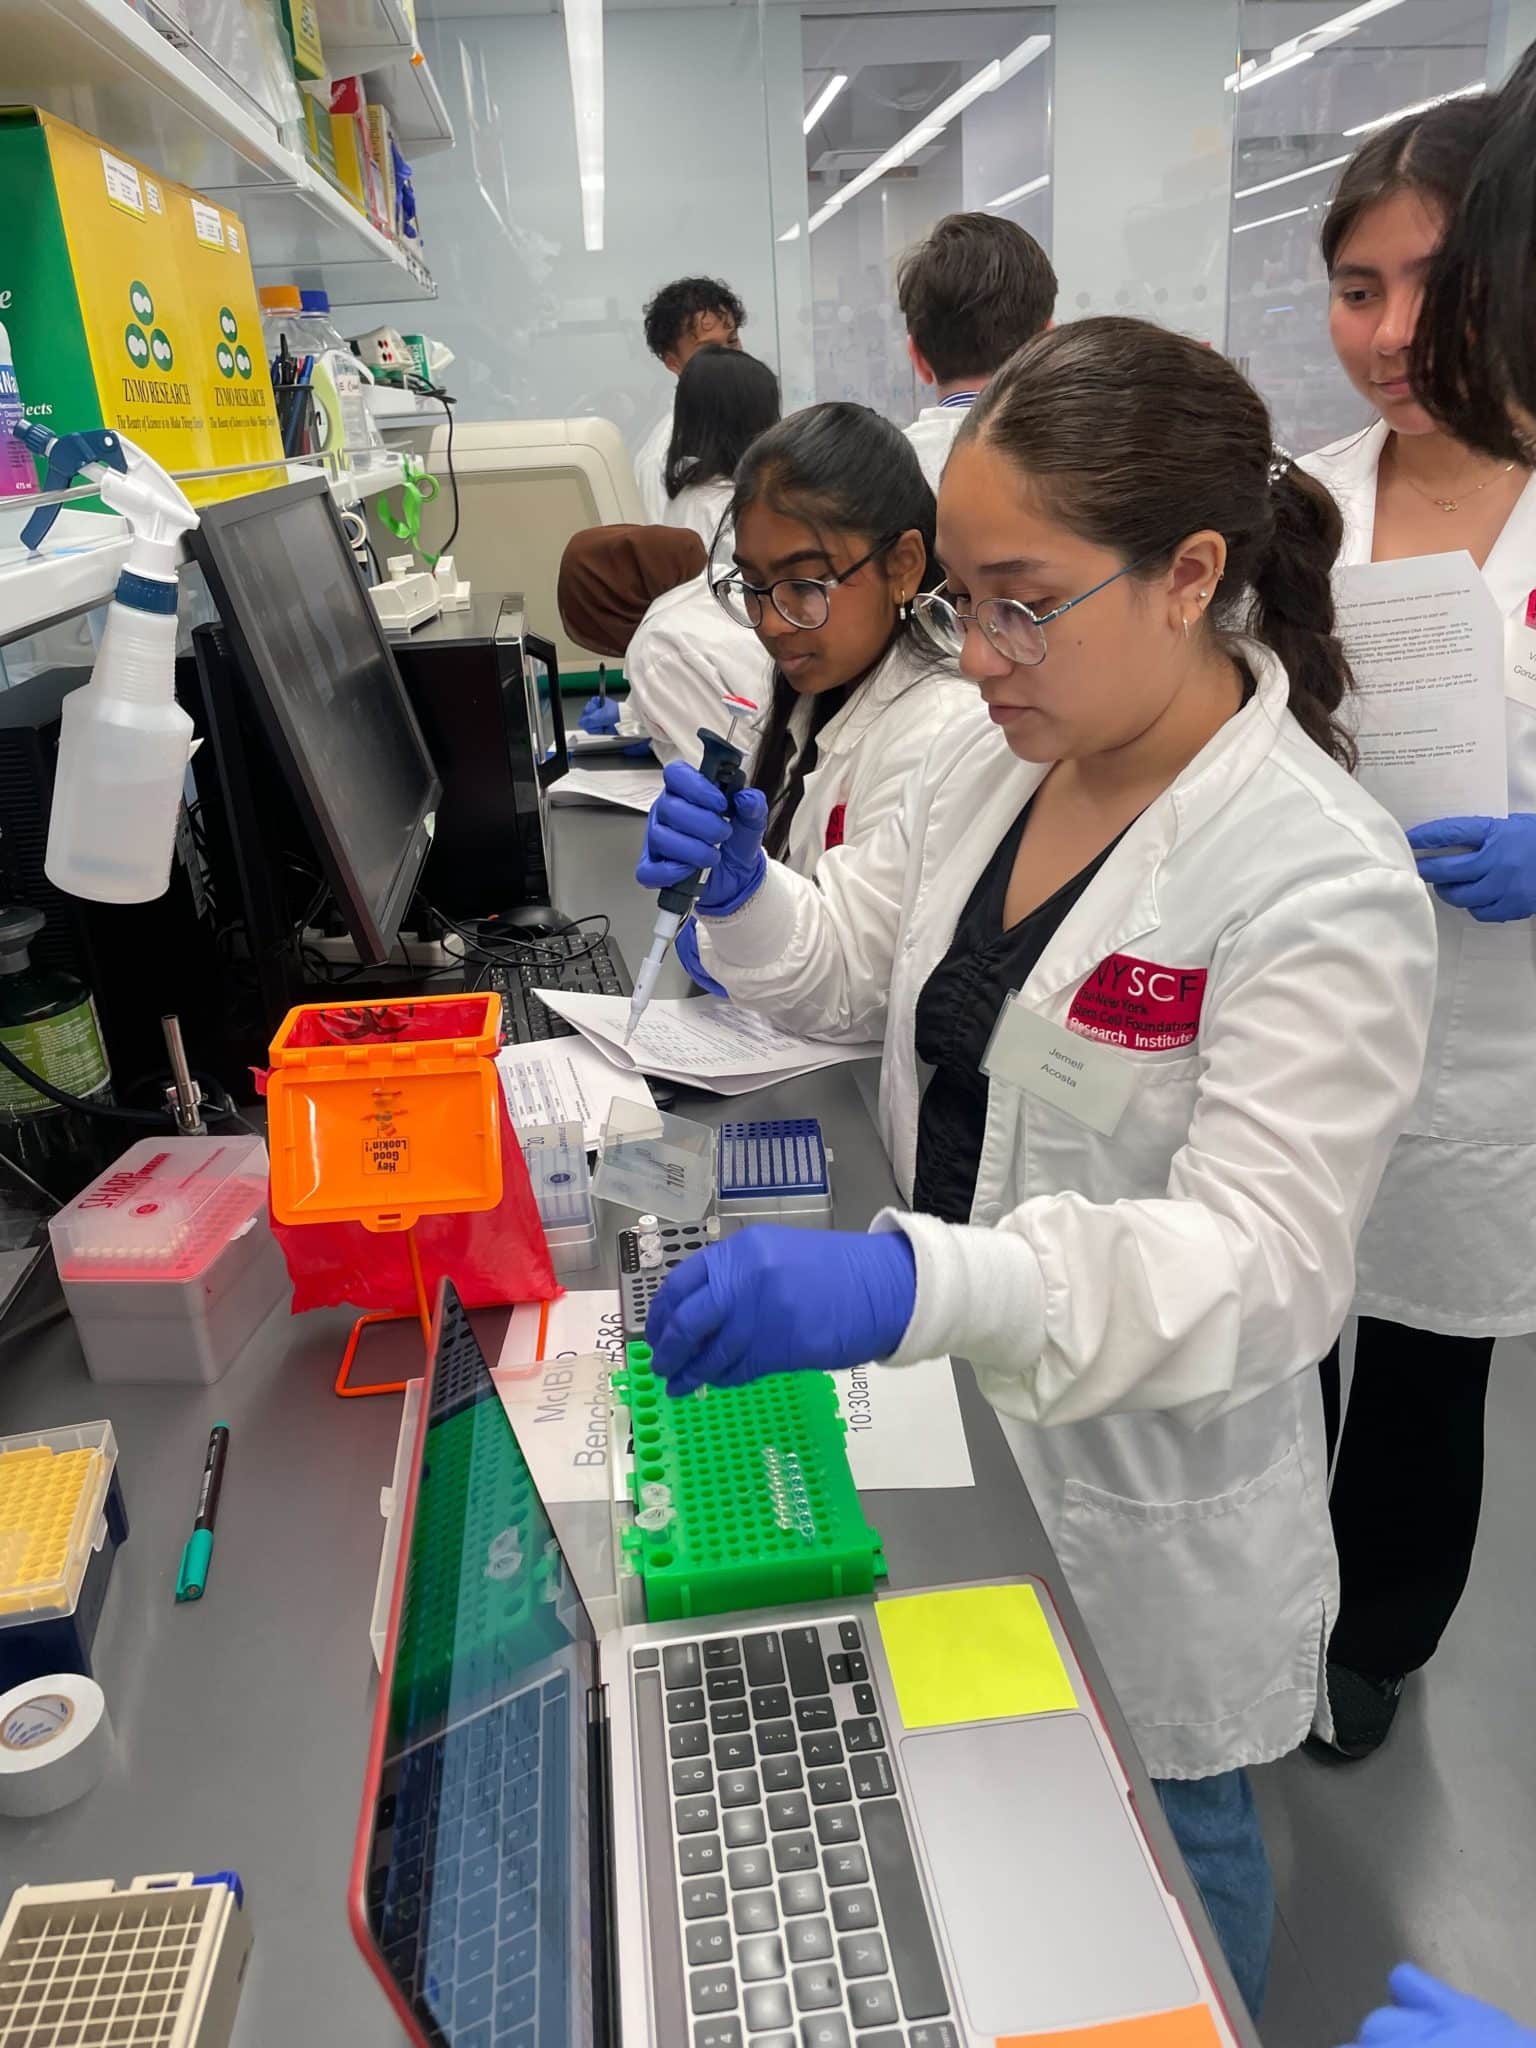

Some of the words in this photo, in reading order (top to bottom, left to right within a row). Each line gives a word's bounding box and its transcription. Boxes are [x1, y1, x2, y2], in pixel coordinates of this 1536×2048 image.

[122, 378, 149, 402] ZYMO
[148, 381, 192, 405] RESEARCH
[1071, 1017, 1127, 1045] Research
[1135, 1033, 1194, 1048] Institute
[1125, 1015, 1200, 1034] Foundation
[1040, 1063, 1077, 1088] Acosta
[373, 1151, 399, 1163] Good
[377, 1161, 396, 1172] Hey
[848, 1366, 873, 1433] 10:30am
